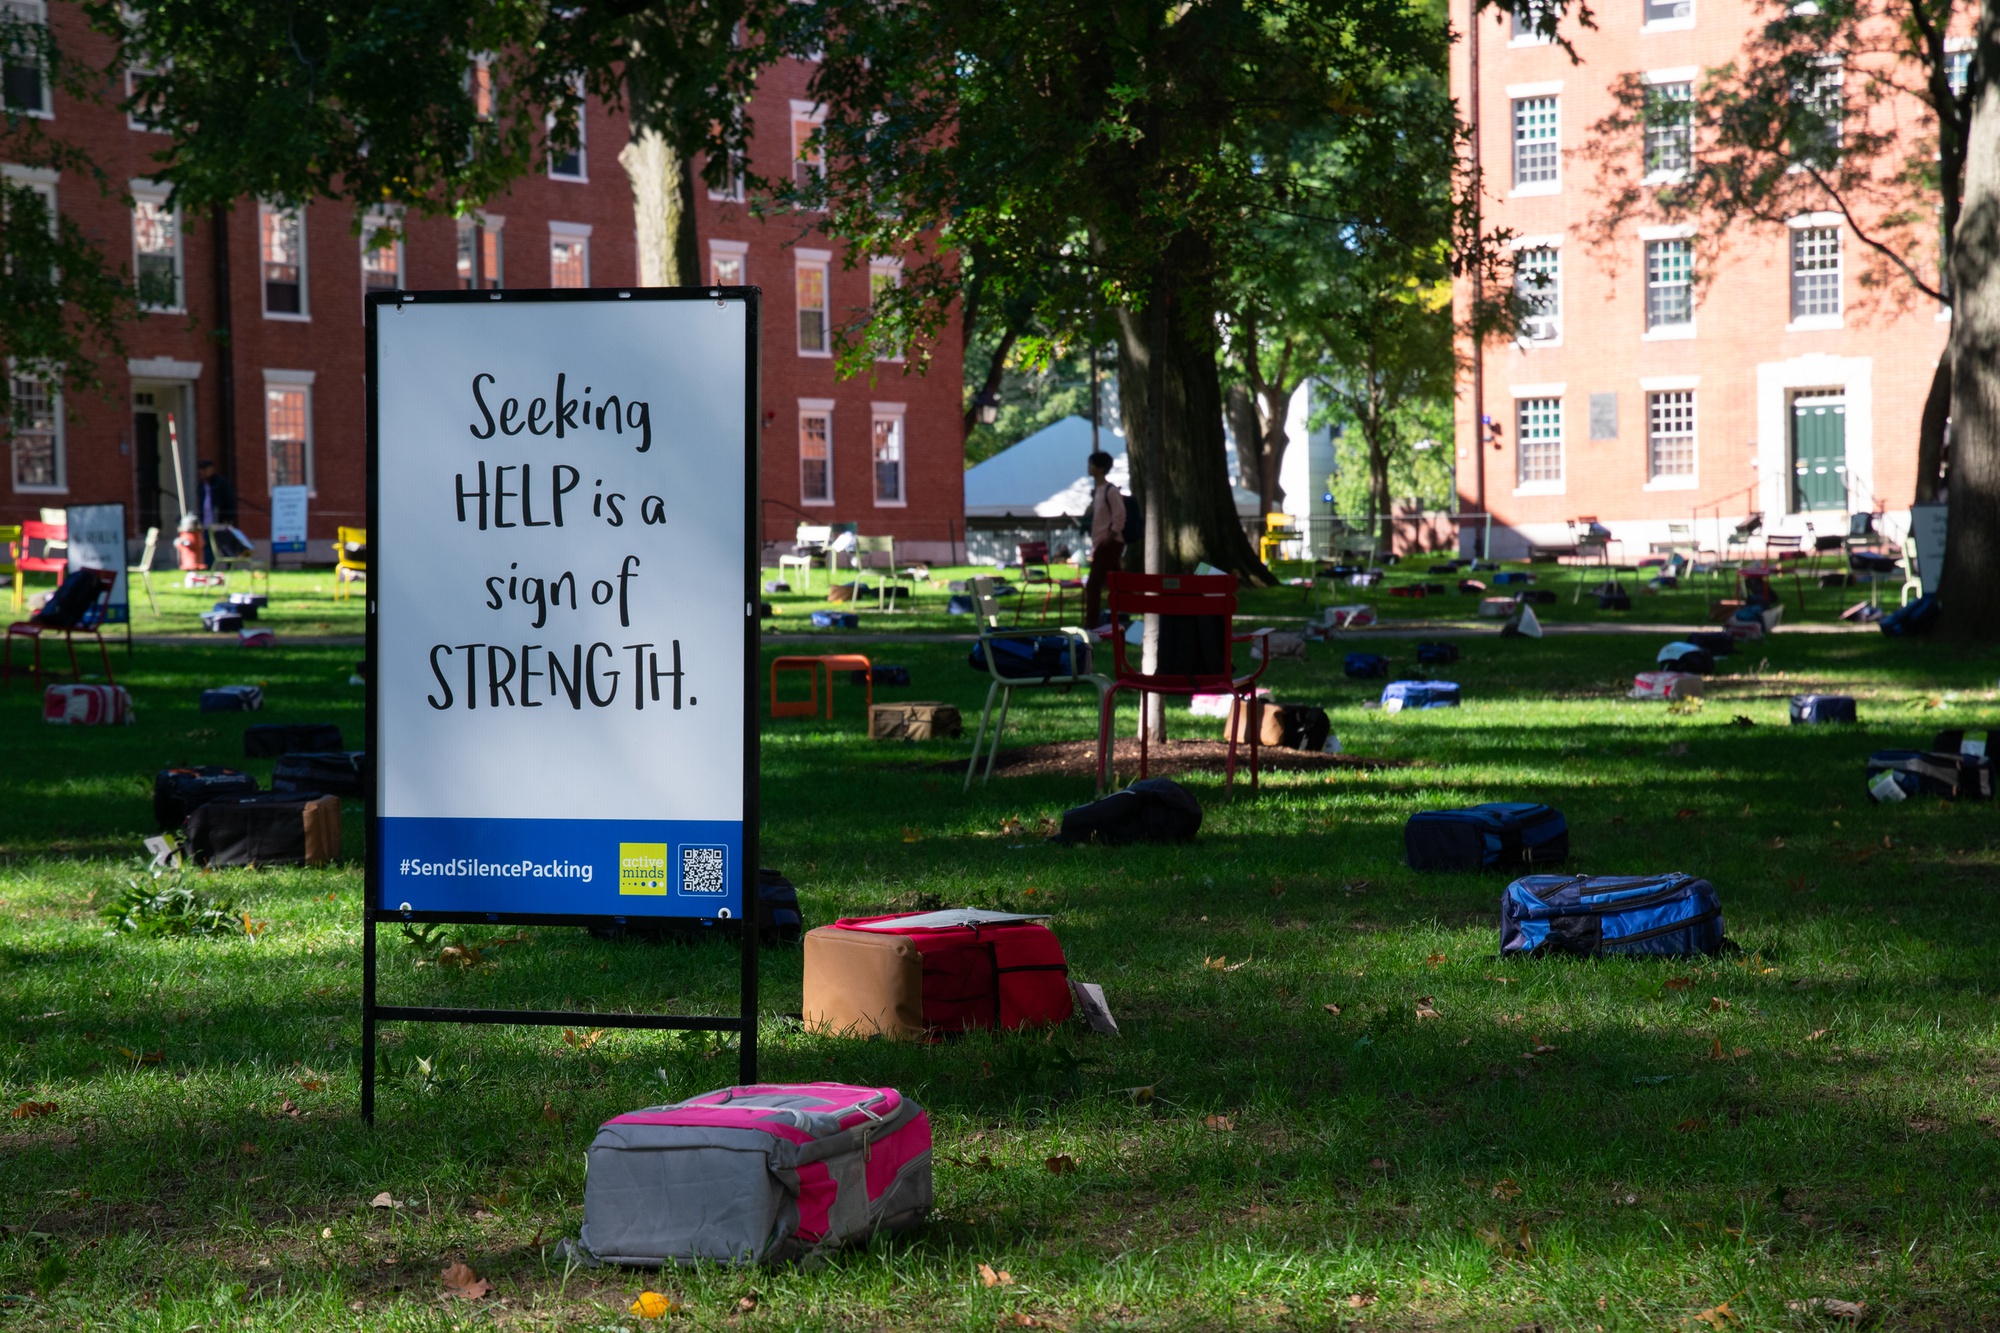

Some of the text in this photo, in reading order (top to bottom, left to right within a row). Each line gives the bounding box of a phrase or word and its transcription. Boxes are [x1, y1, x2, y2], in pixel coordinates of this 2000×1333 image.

[469, 372, 652, 454] Seeking
[455, 460, 667, 531] HELP is a
[485, 554, 641, 629] sign of
[427, 639, 698, 711] STRENGTH.
[399, 858, 593, 883] #SendSilencePacking
[622, 855, 664, 869] active
[622, 866, 664, 879] minds
